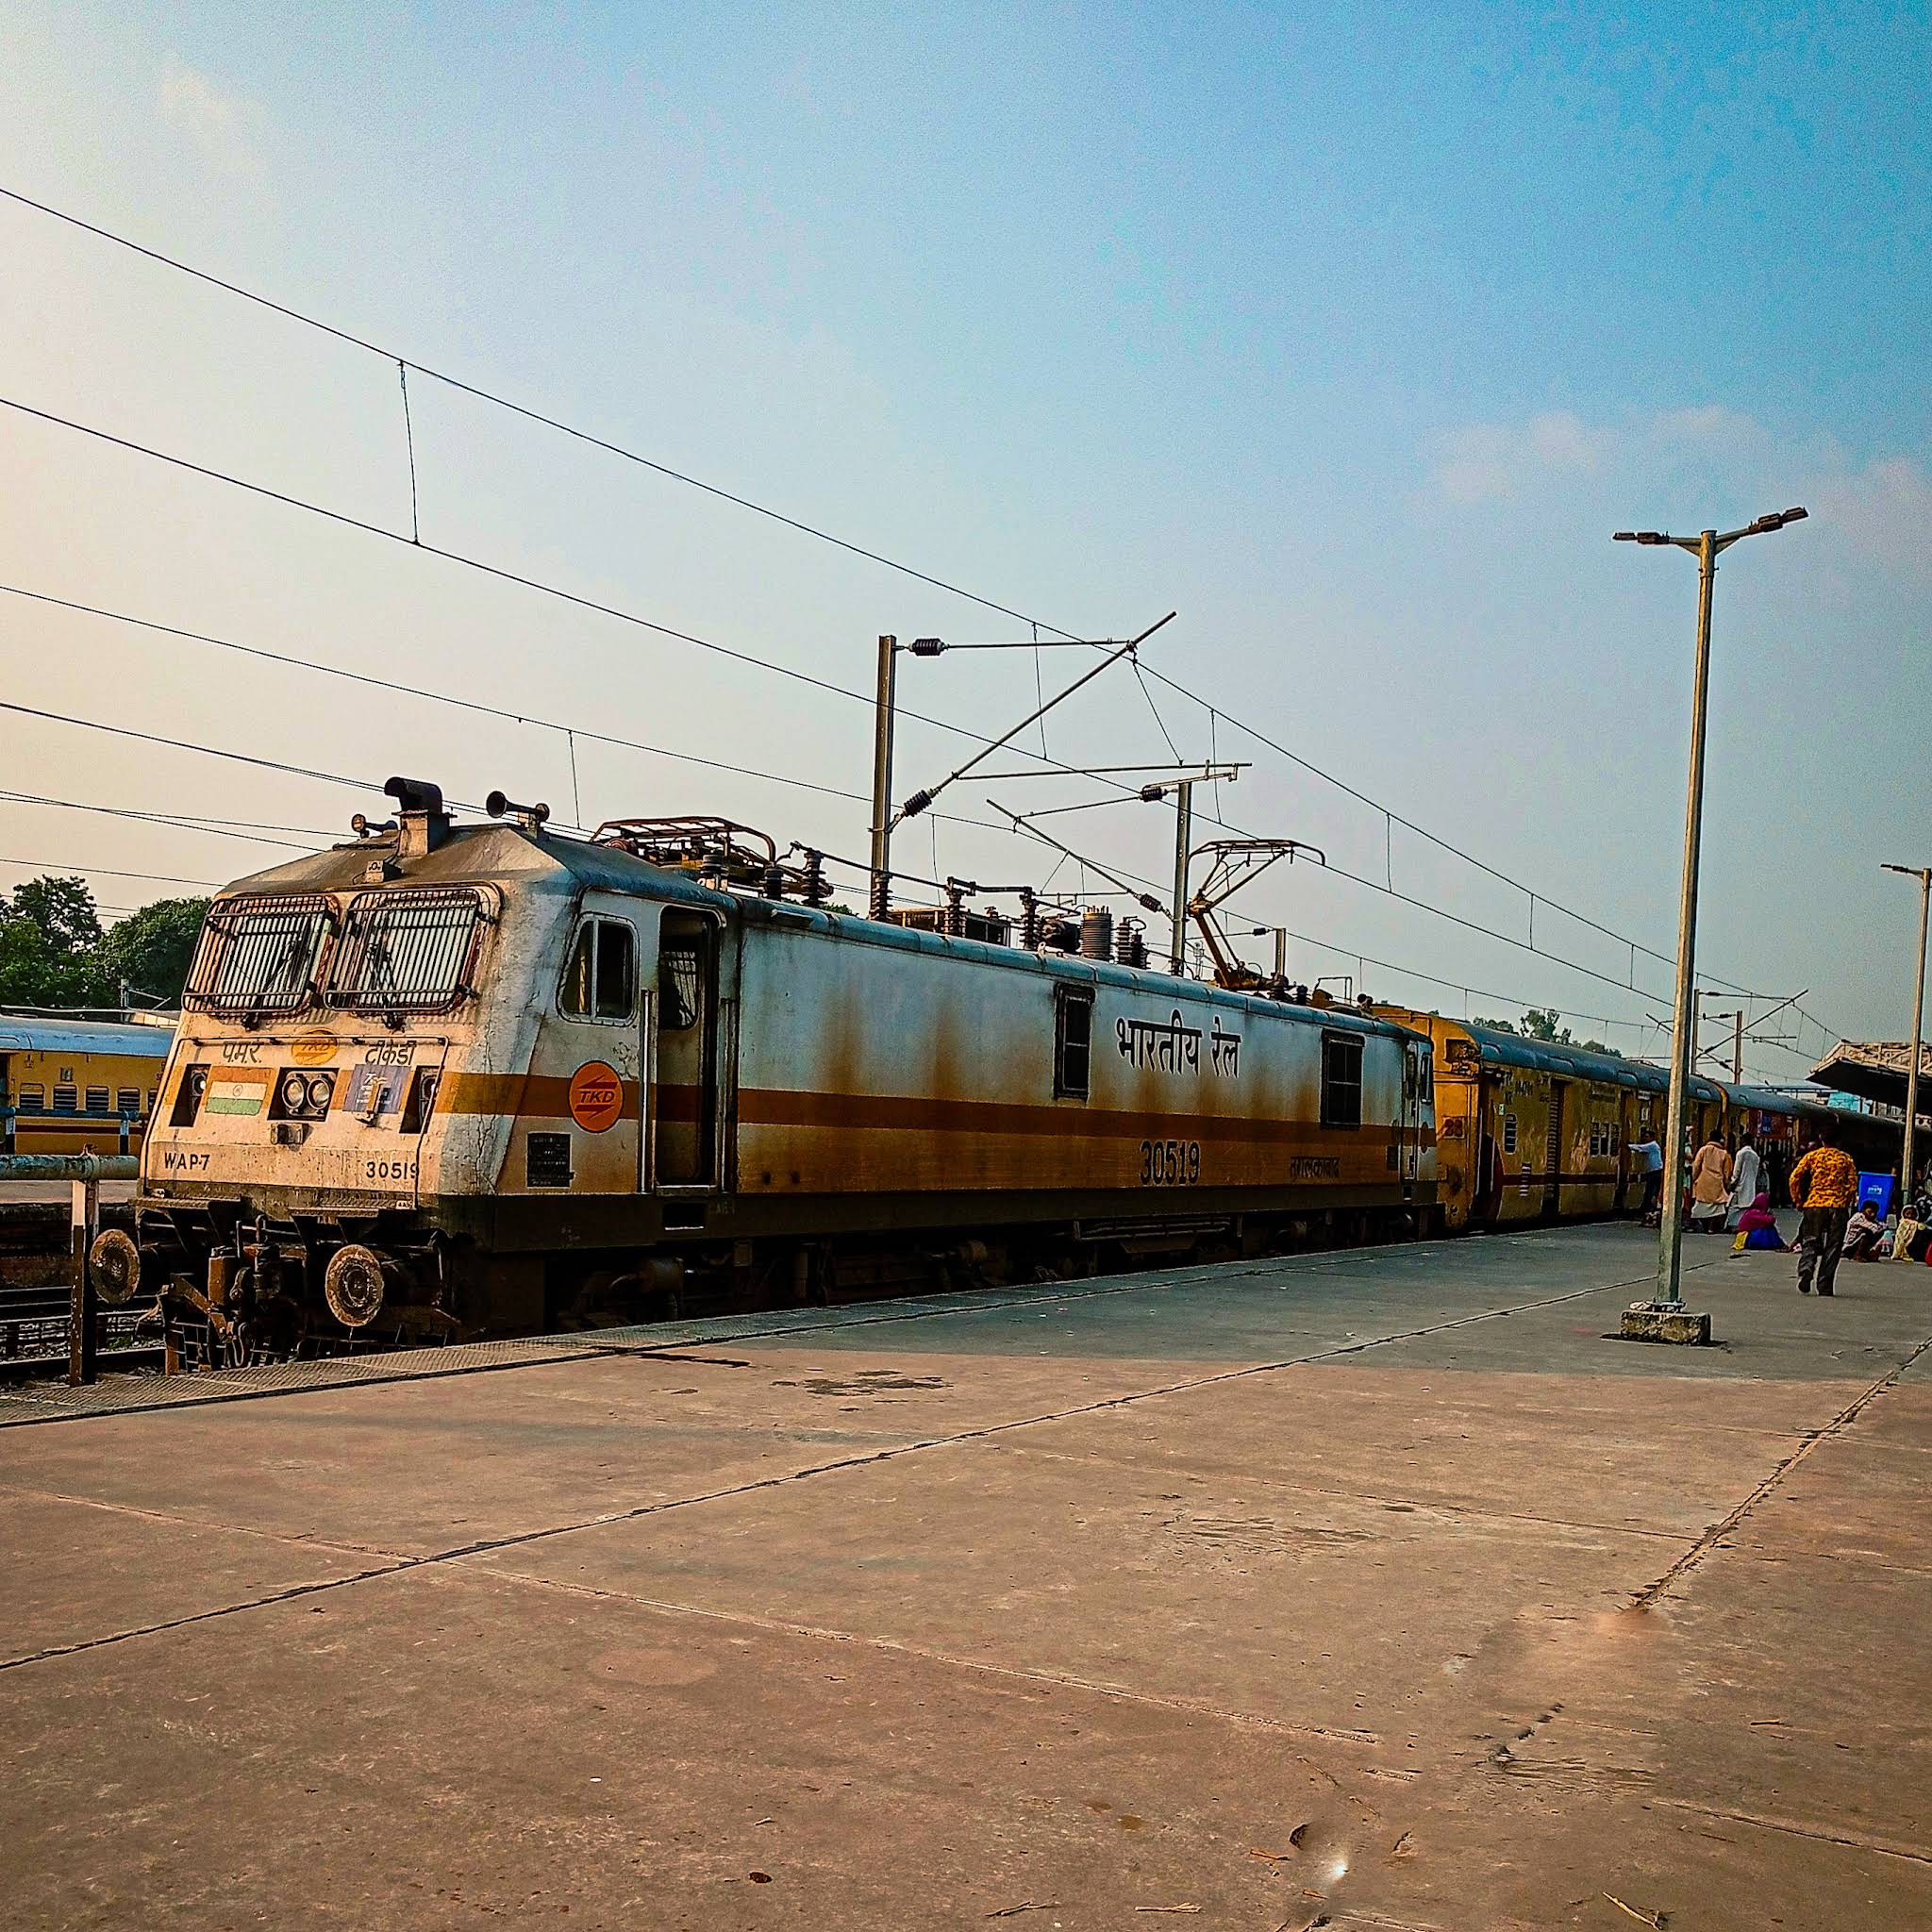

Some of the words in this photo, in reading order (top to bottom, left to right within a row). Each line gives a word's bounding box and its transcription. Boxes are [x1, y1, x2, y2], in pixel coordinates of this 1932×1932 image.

[1115, 1008, 1203, 1076] भारतीय
[1209, 1014, 1242, 1078] रेल
[578, 1091, 615, 1104] TKD
[365, 1161, 419, 1179] 30519
[1139, 1139, 1201, 1185] 30519
